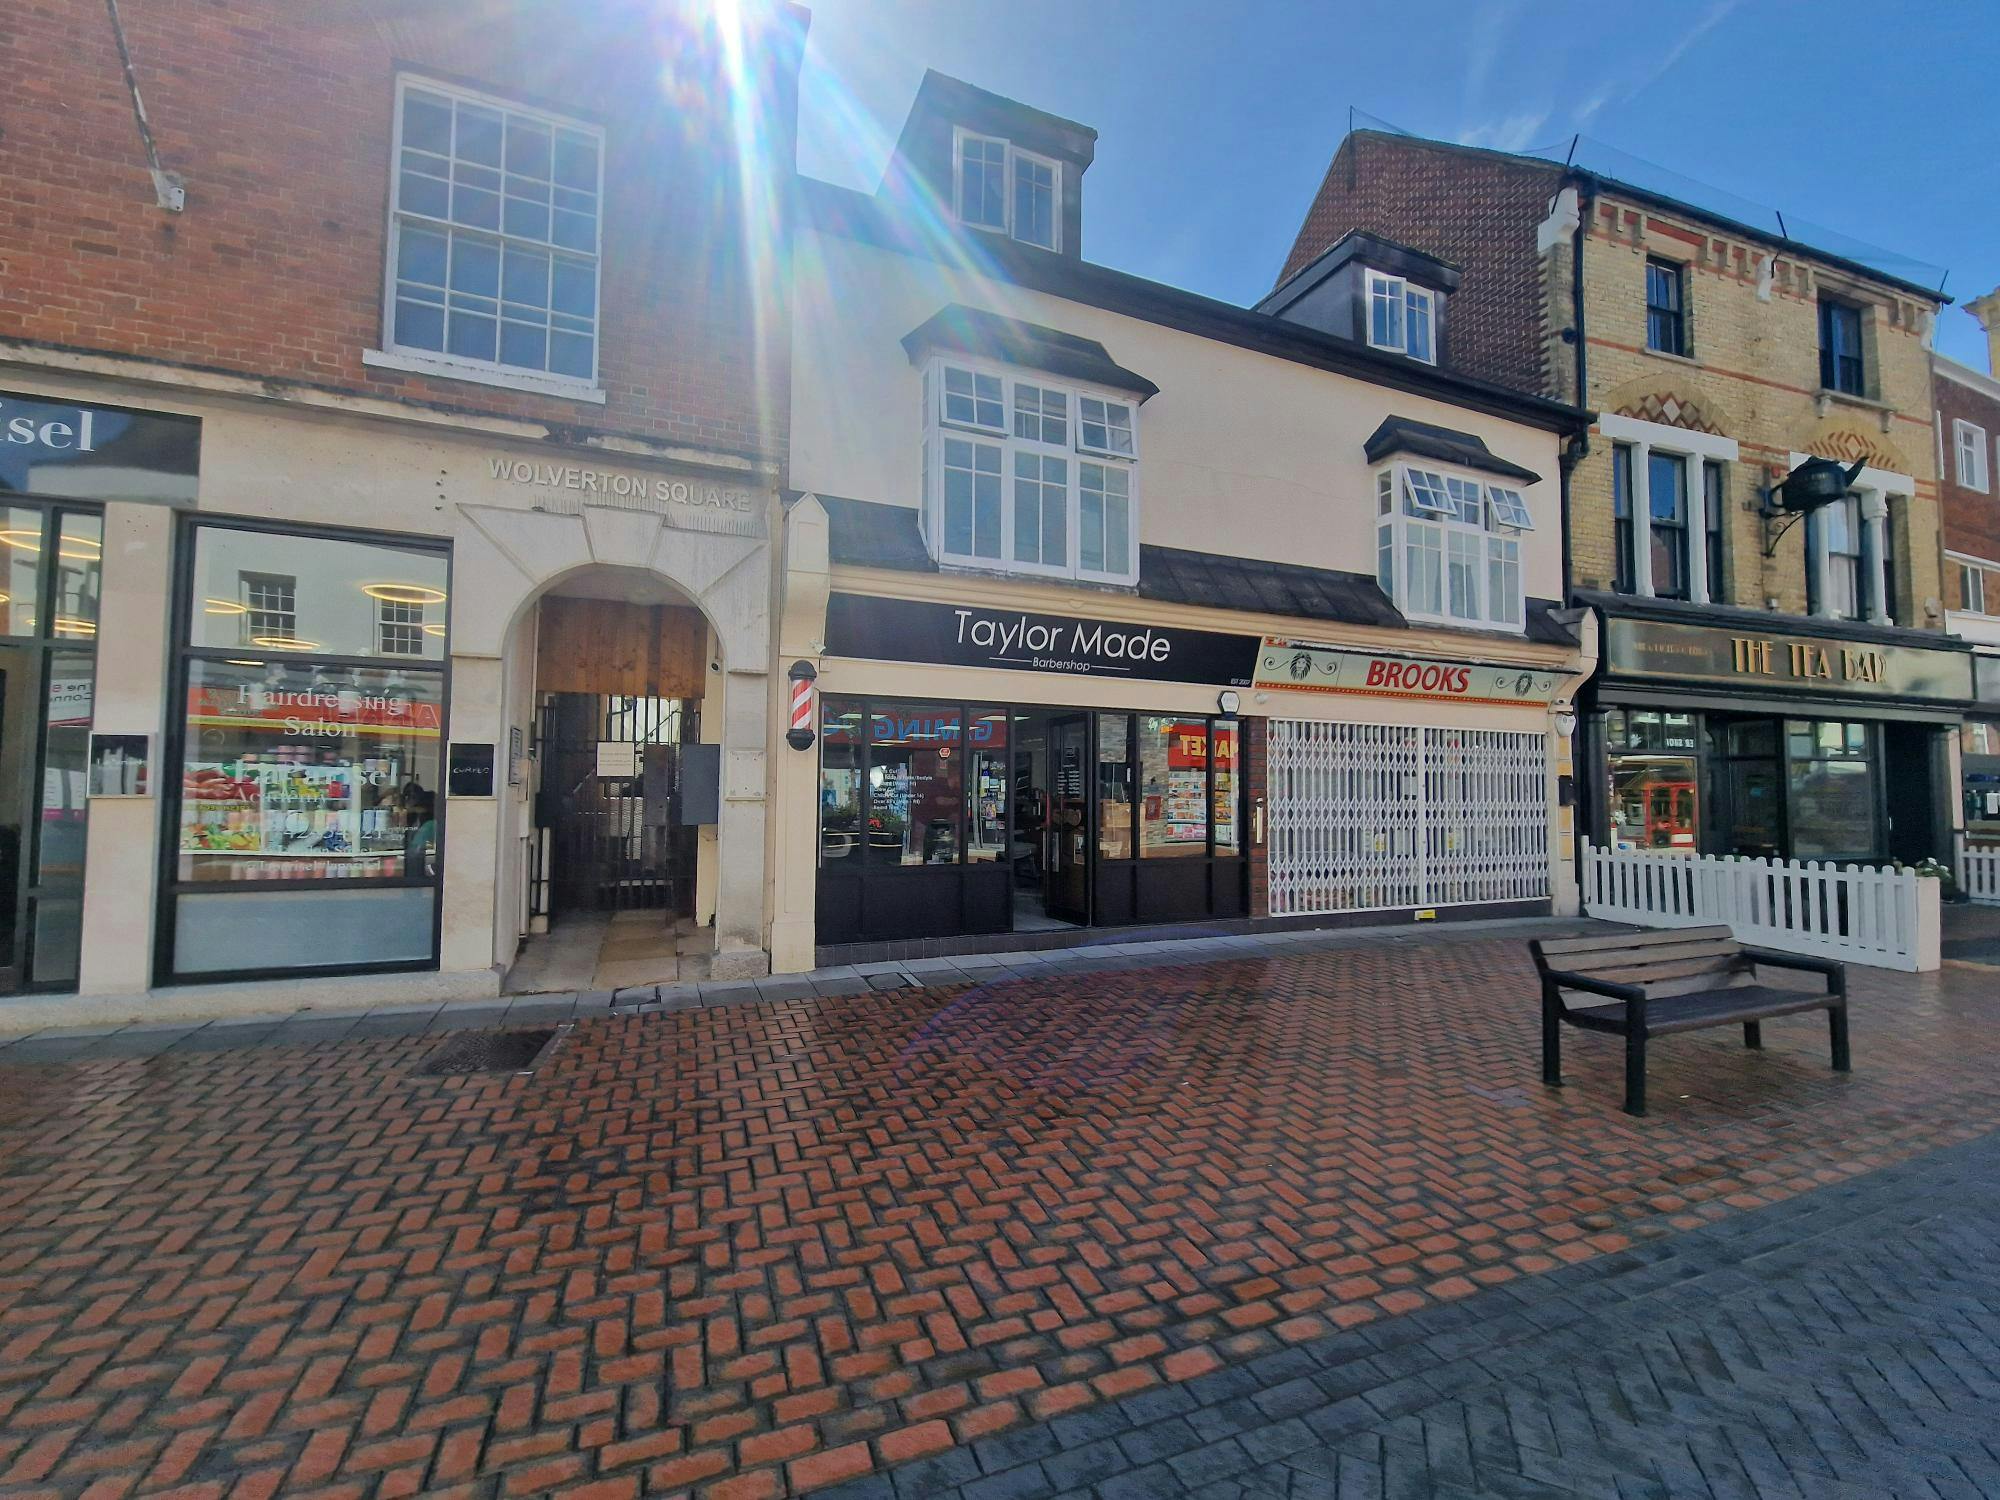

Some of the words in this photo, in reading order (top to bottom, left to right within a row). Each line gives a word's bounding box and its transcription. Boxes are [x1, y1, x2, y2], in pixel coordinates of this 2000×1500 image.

[0, 401, 96, 452] sel
[488, 457, 648, 498] WOLVERTON
[655, 480, 751, 513] SQUARE
[955, 610, 1063, 655] Taylor
[1070, 623, 1171, 662] Made
[1033, 657, 1091, 672] Barbershop
[1366, 660, 1471, 693] BROOKS
[1731, 638, 1775, 675] THE
[1788, 643, 1832, 679] TEA
[1841, 648, 1887, 684] BAR
[284, 717, 356, 738] Salon
